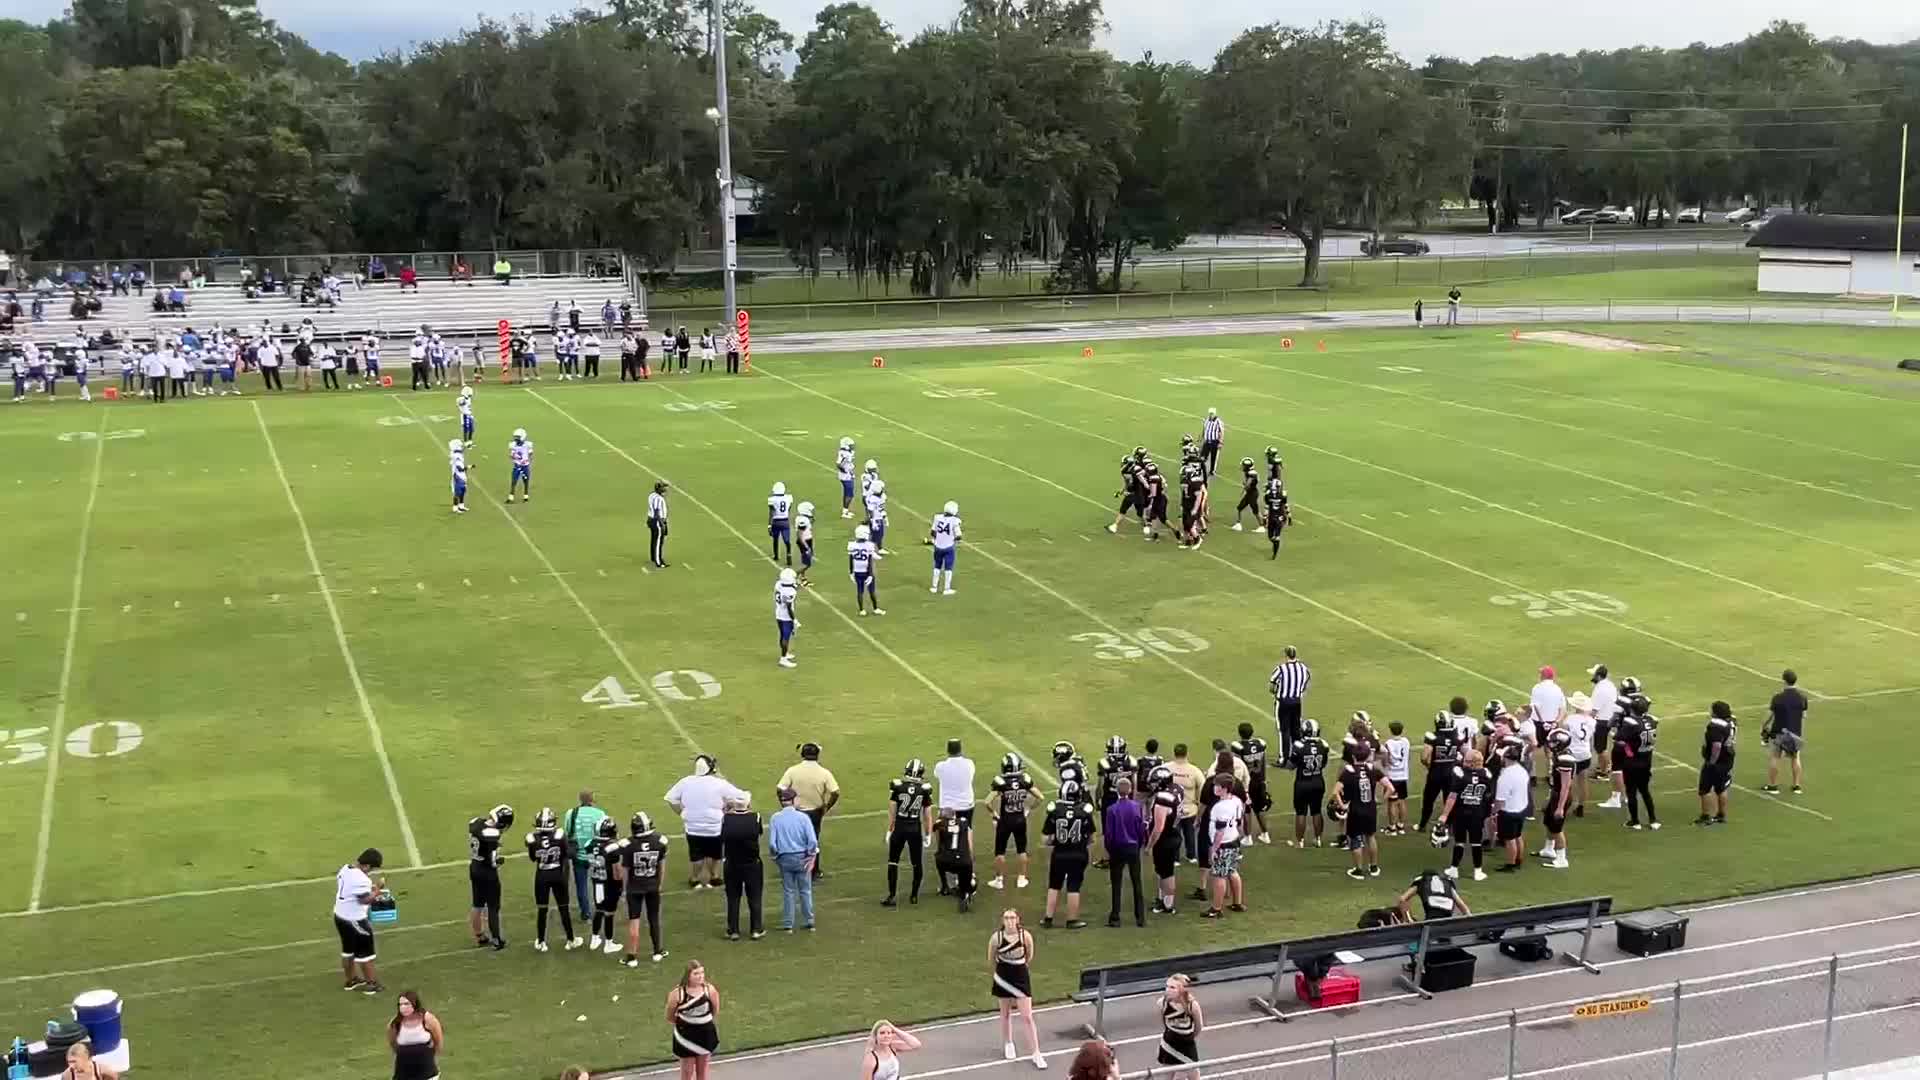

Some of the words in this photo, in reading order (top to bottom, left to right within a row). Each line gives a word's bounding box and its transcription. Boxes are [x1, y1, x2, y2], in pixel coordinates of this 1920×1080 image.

[779, 501, 786, 512] 8
[937, 522, 950, 536] 54
[1069, 627, 1211, 660] 30
[581, 670, 722, 709] 40
[1580, 723, 1587, 740] 5
[0, 721, 144, 765] 50
[1056, 819, 1081, 843] 64
[1586, 1005, 1598, 1015] NO
[1600, 1000, 1639, 1013] STANDING
